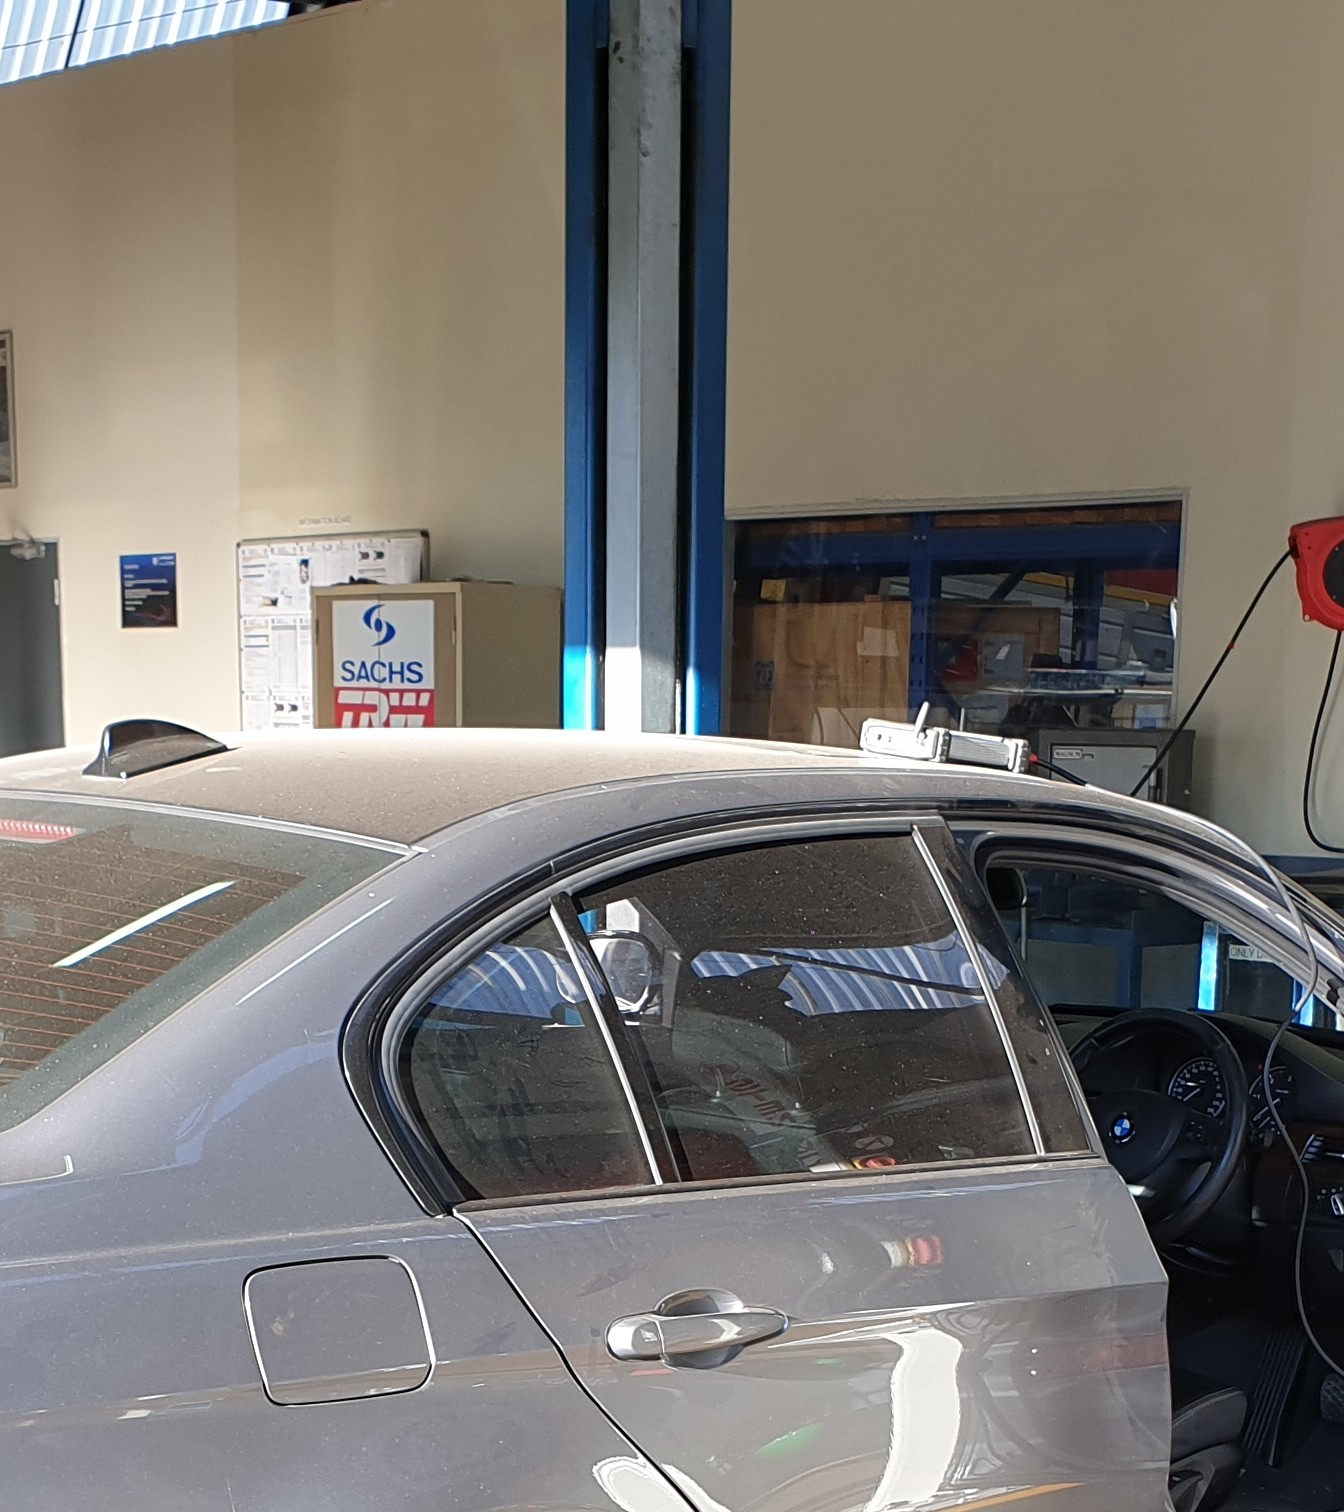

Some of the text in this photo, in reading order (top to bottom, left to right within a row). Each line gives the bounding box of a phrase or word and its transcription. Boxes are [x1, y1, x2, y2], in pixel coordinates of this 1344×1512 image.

[340, 660, 424, 684] SACHS
[337, 690, 431, 728] TRW
[1230, 946, 1255, 958] ONLY
